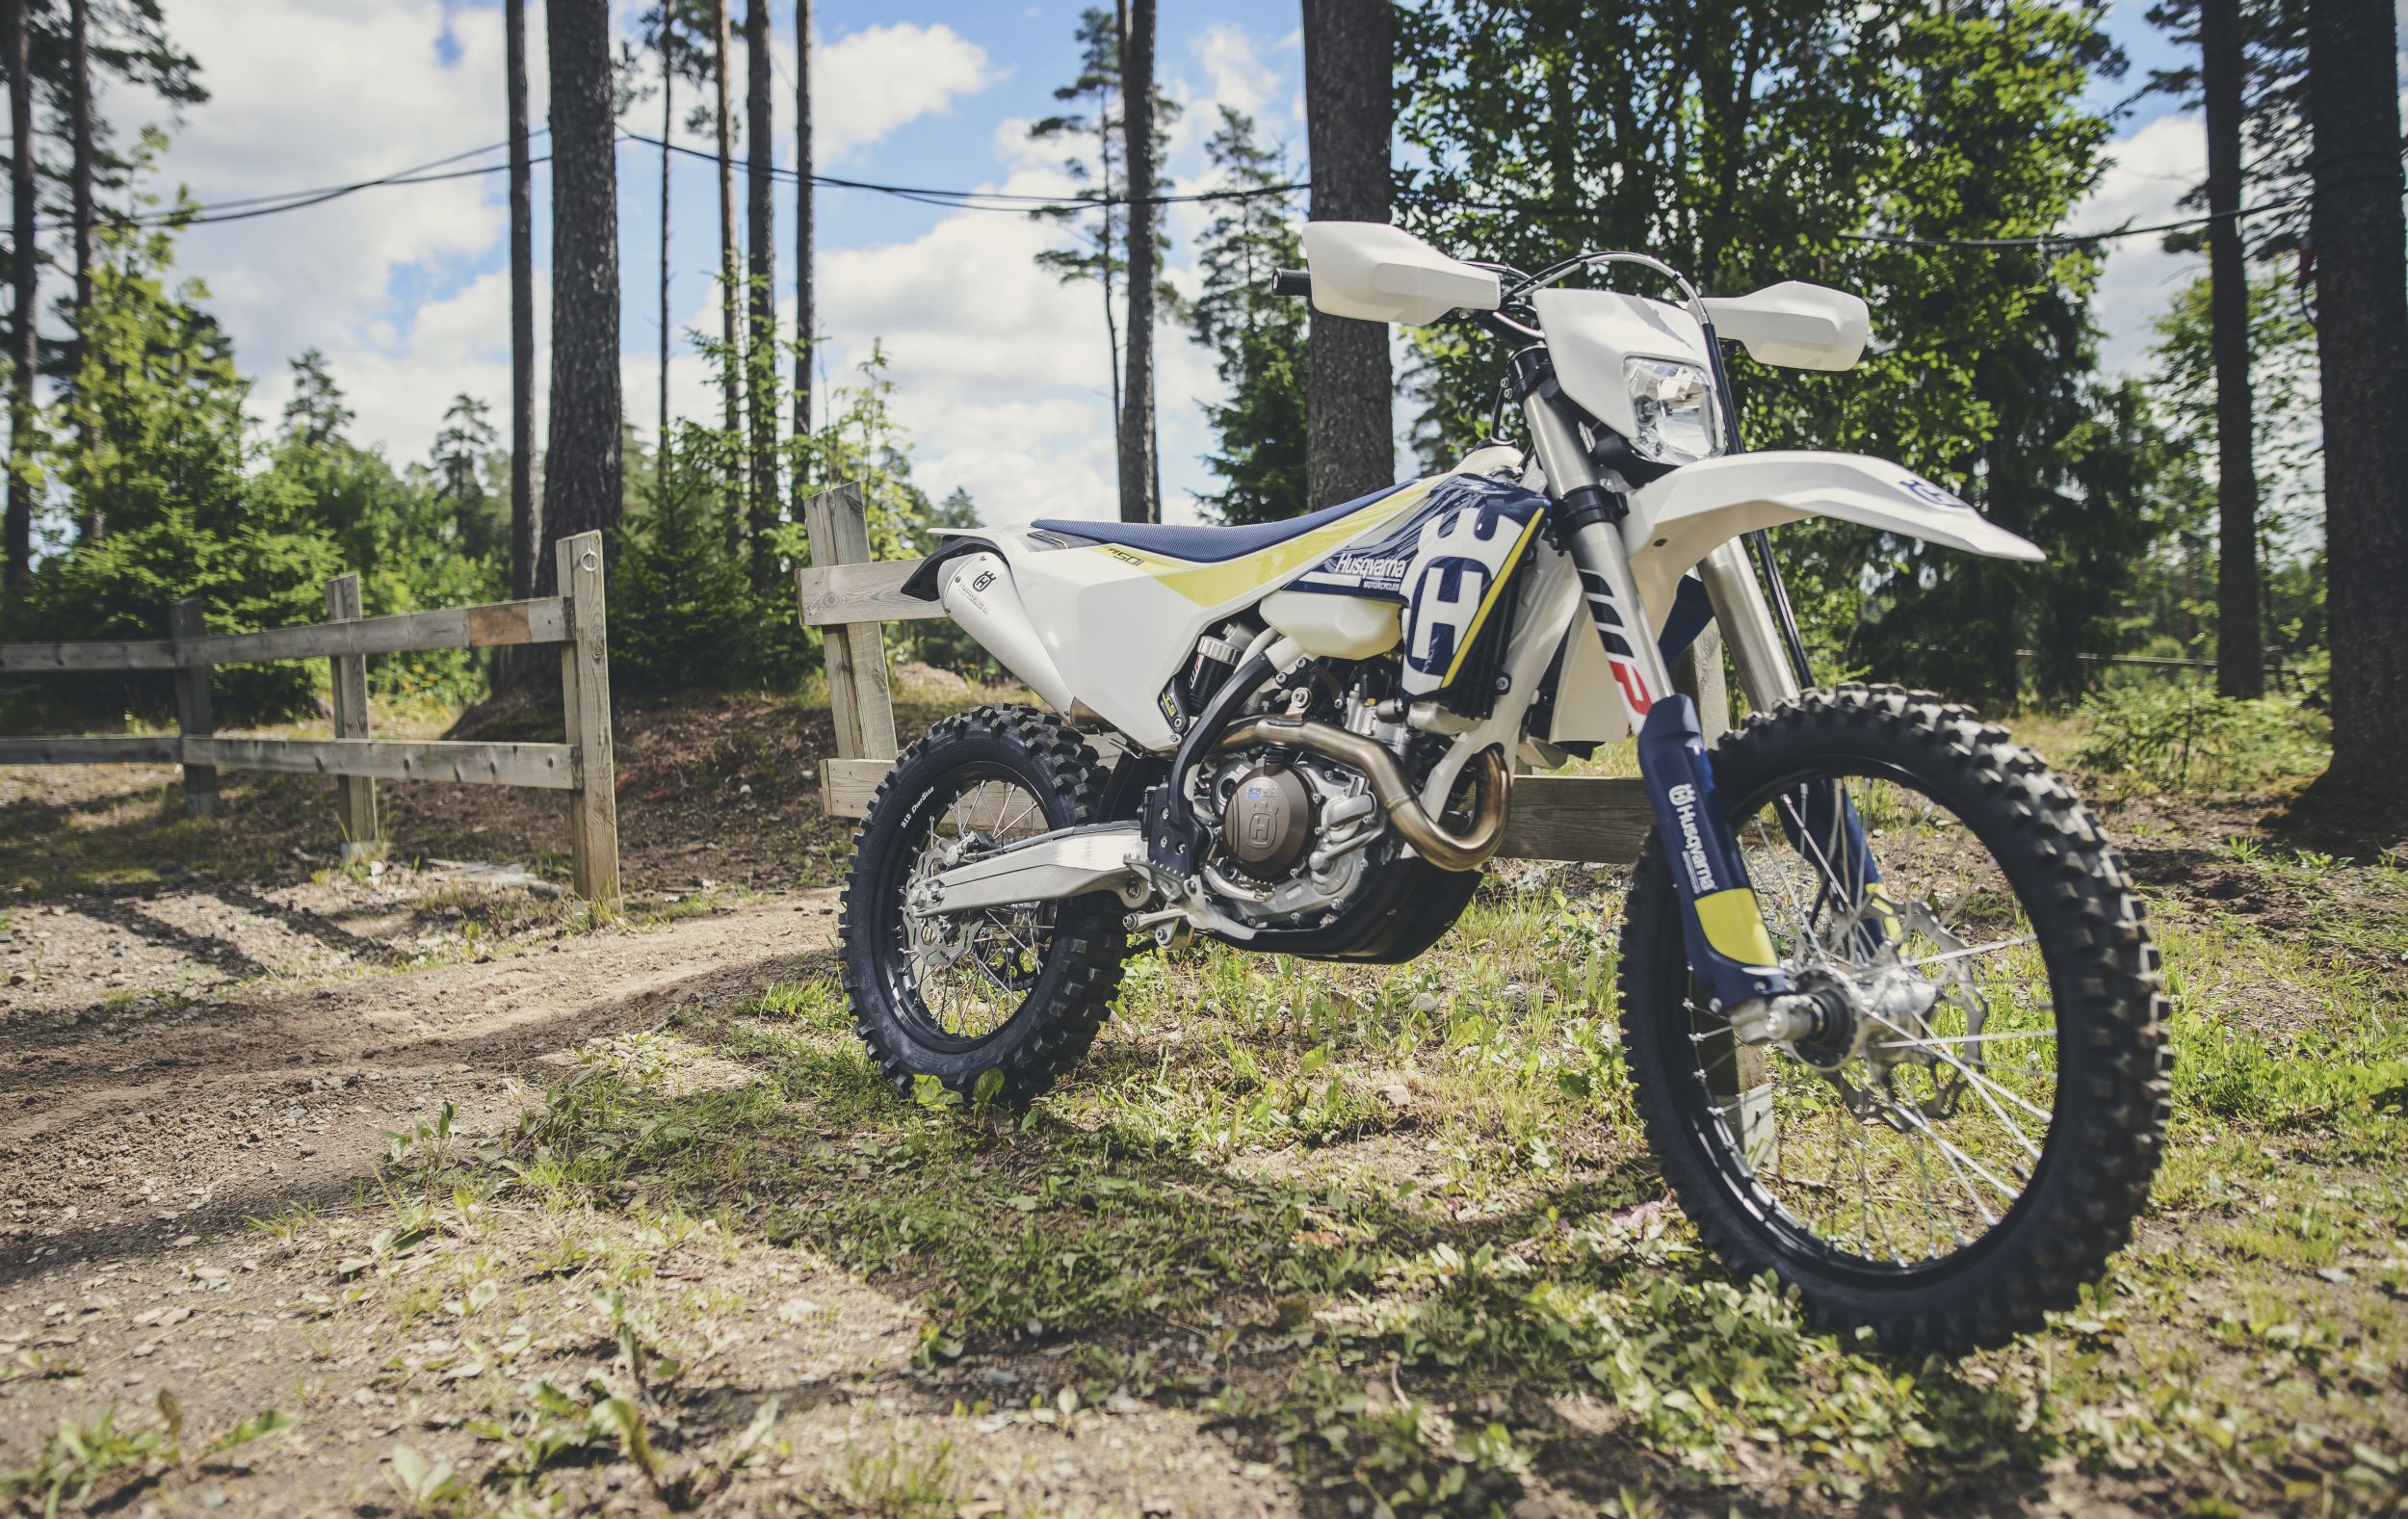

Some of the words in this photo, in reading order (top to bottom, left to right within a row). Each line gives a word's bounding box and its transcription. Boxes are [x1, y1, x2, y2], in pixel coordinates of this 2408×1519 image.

[1112, 552, 1145, 566] 501
[1335, 553, 1407, 580] Husqvarna
[1363, 581, 1400, 592] MOTORCYCLES
[1677, 803, 1715, 892] Husqvarna
